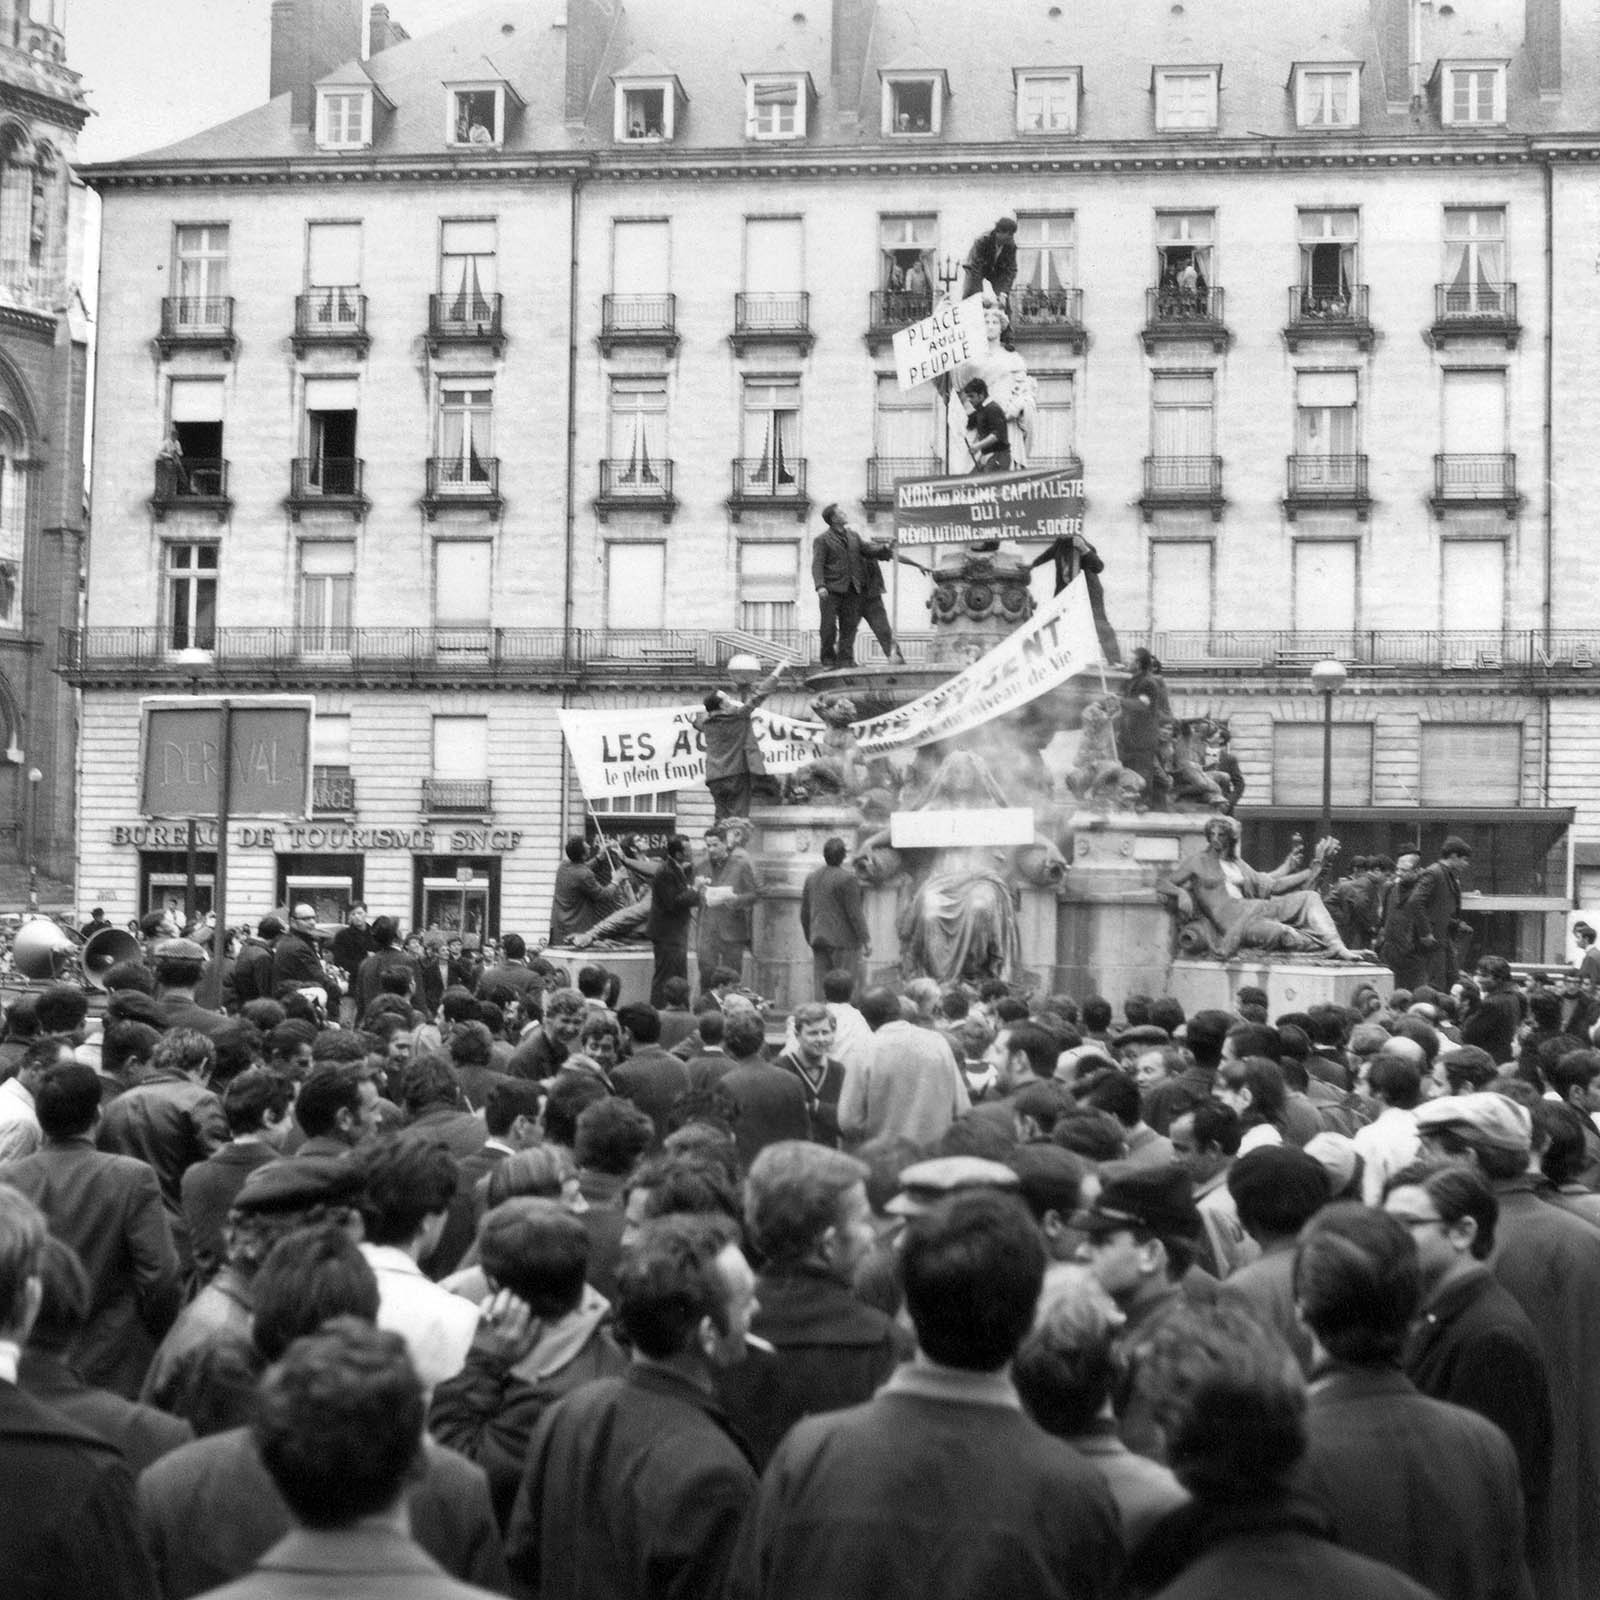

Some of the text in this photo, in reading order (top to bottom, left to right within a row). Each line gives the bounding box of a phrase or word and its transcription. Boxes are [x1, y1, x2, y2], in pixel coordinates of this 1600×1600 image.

[907, 306, 961, 346] PLACE
[909, 341, 971, 384] PEUPLE
[898, 484, 934, 508] NON
[1001, 475, 1084, 502] CAPITALISTE
[897, 521, 973, 544] RÉVOLUTION
[602, 732, 656, 763] LES
[604, 767, 619, 786] le
[623, 764, 660, 788] plein
[238, 826, 276, 848] DE
[289, 828, 435, 850] TOURISME
[451, 829, 523, 850] SNCF
